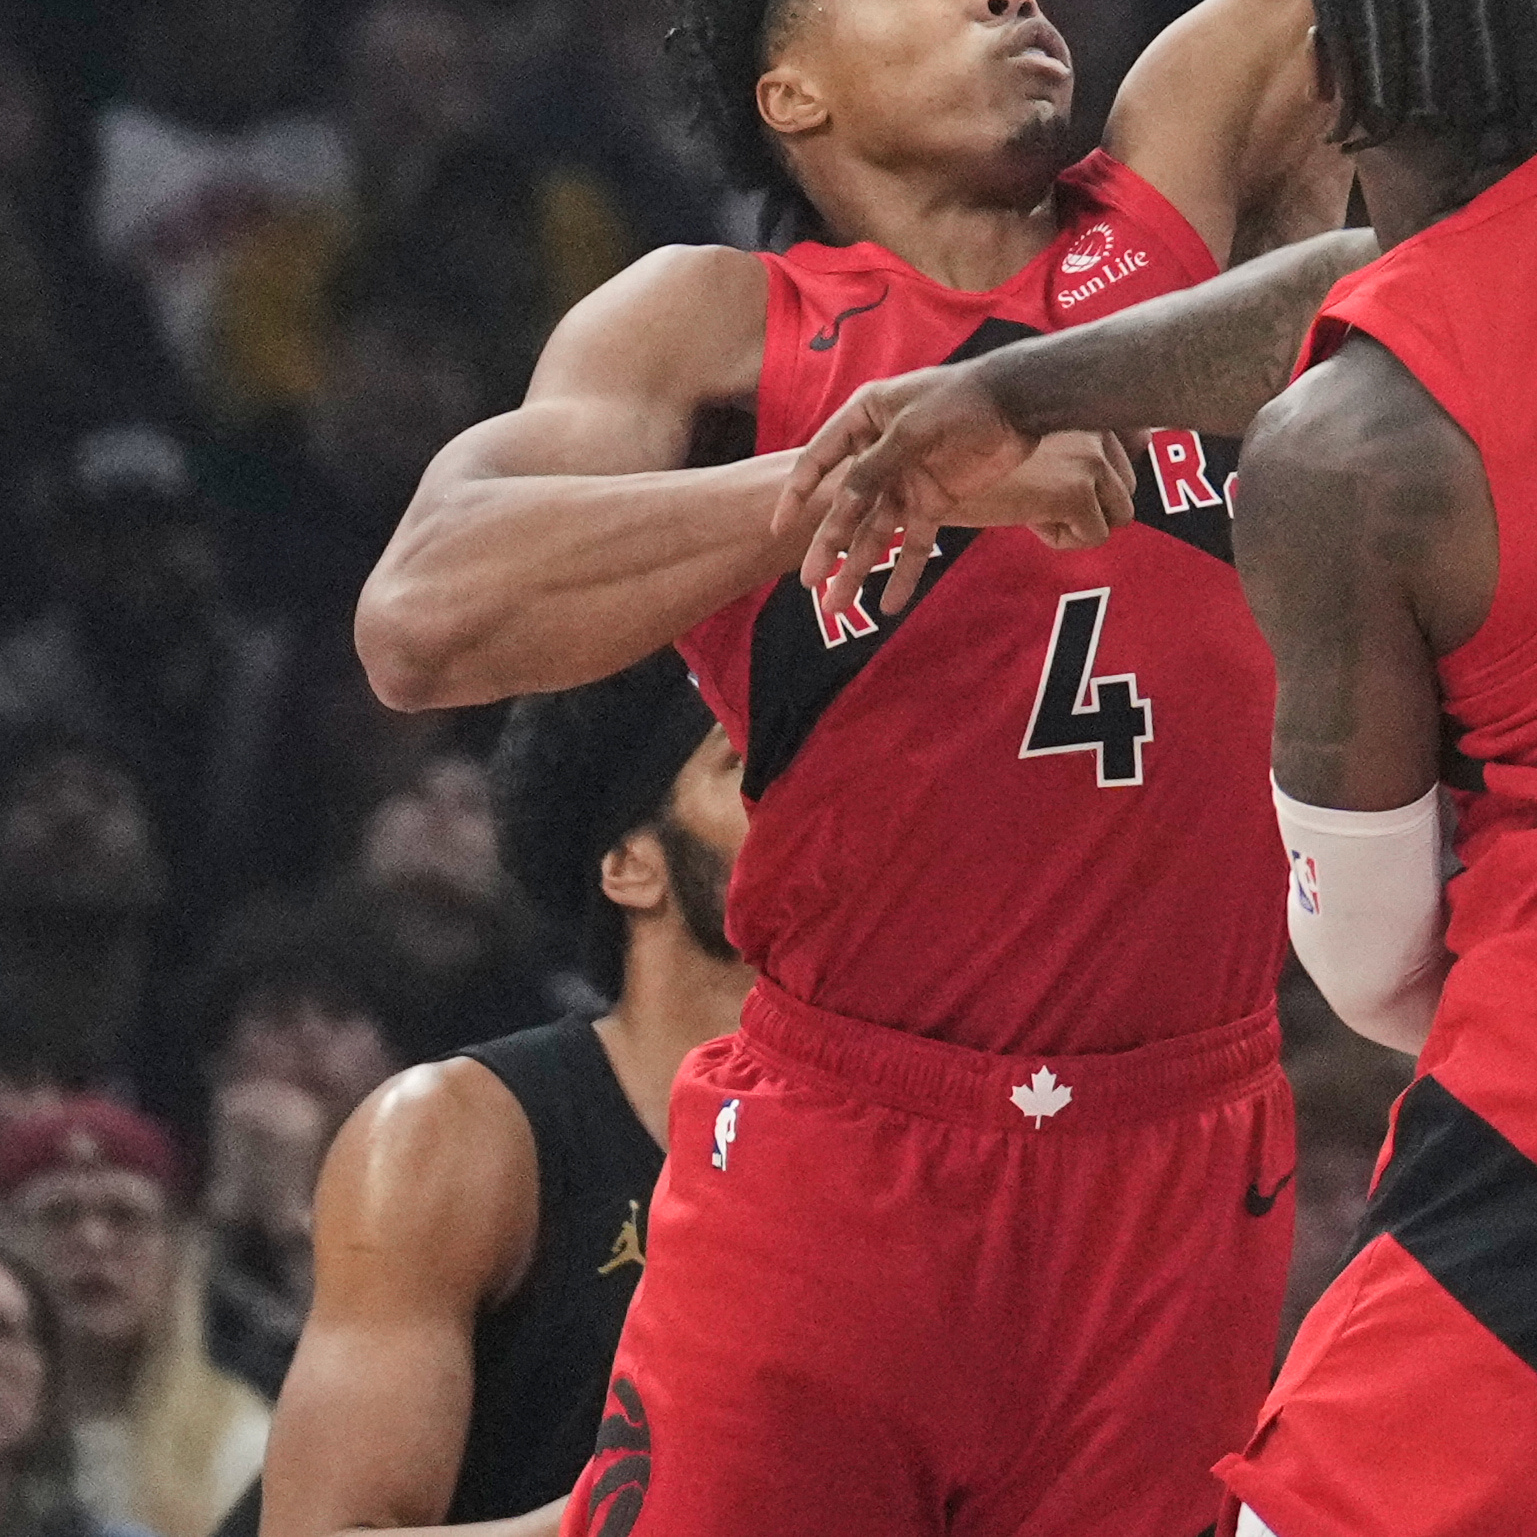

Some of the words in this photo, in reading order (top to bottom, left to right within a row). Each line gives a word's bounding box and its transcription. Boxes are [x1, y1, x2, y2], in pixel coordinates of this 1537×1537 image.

[1057, 276, 1105, 309] Sun
[1101, 248, 1150, 284] Life
[1017, 585, 1154, 788] 4
